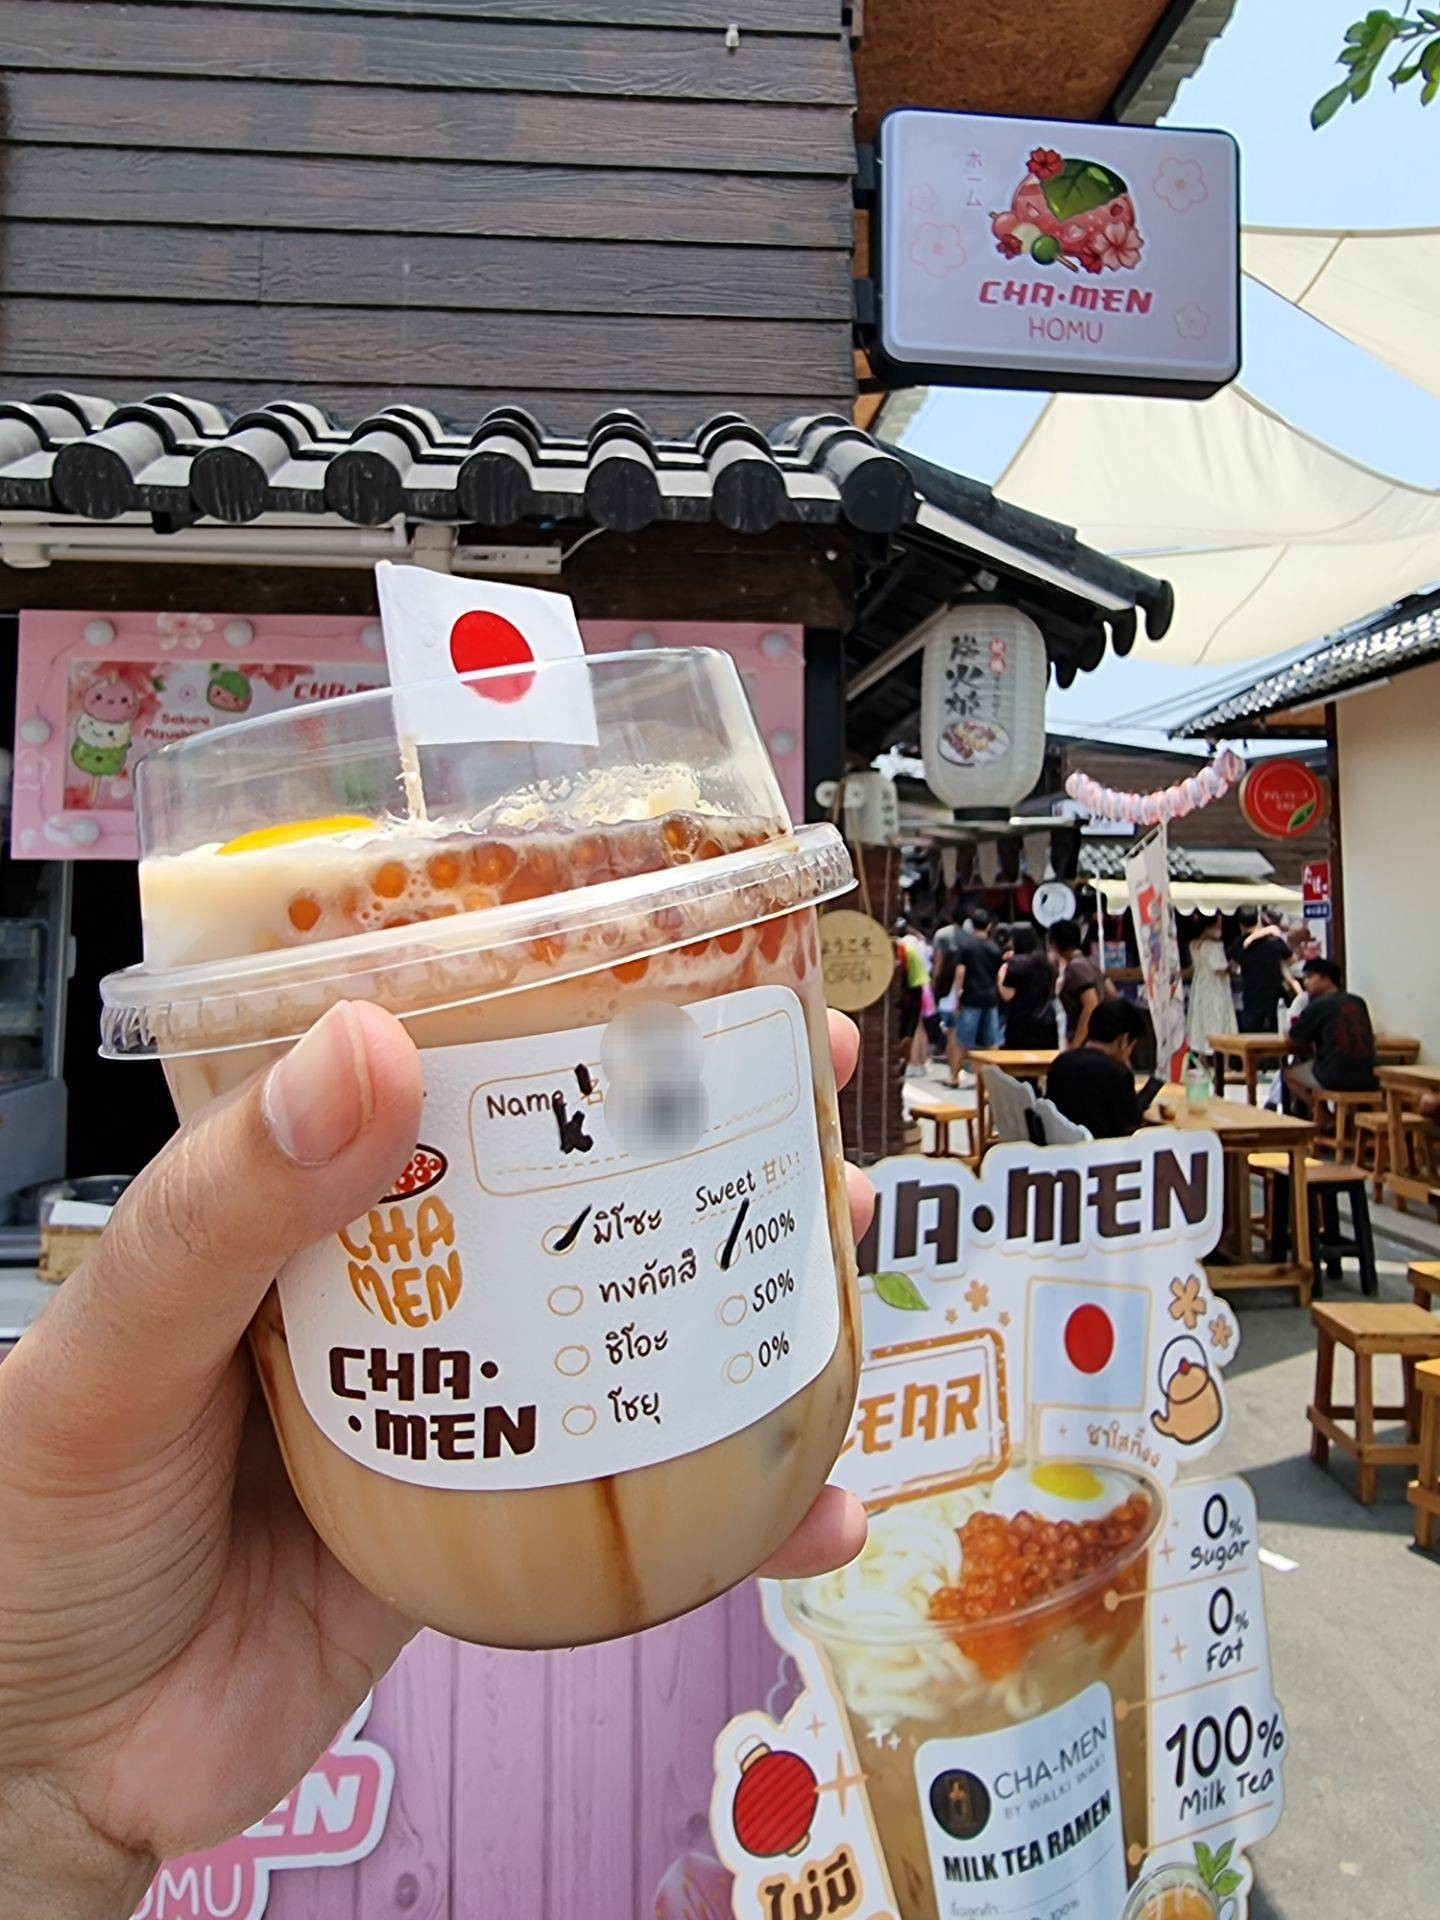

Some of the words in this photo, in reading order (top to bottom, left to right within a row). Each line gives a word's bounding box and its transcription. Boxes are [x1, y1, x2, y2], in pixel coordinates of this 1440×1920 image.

[1028, 317, 1104, 343] HOMU
[486, 1090, 565, 1119] Name
[695, 1169, 757, 1213] Sweet
[593, 1202, 663, 1244] มิโซะ
[745, 1208, 796, 1254] 100%
[347, 1249, 464, 1329] MEN
[752, 1268, 795, 1312] 50%
[605, 1321, 669, 1365] ชิโอะ
[758, 1330, 790, 1368] 0%
[608, 1386, 662, 1424] โชยุ
[1189, 1537, 1251, 1572] Sugar
[1206, 1637, 1245, 1673] Fat
[993, 1723, 1108, 1801] CHA-MEN
[1165, 1705, 1285, 1788] 100%
[1179, 1780, 1227, 1821] Milk
[1236, 1767, 1275, 1793] Tea
[943, 1853, 999, 1883] MILK
[1002, 1839, 1045, 1878] TEA
[1047, 1789, 1112, 1860] RAMEN
